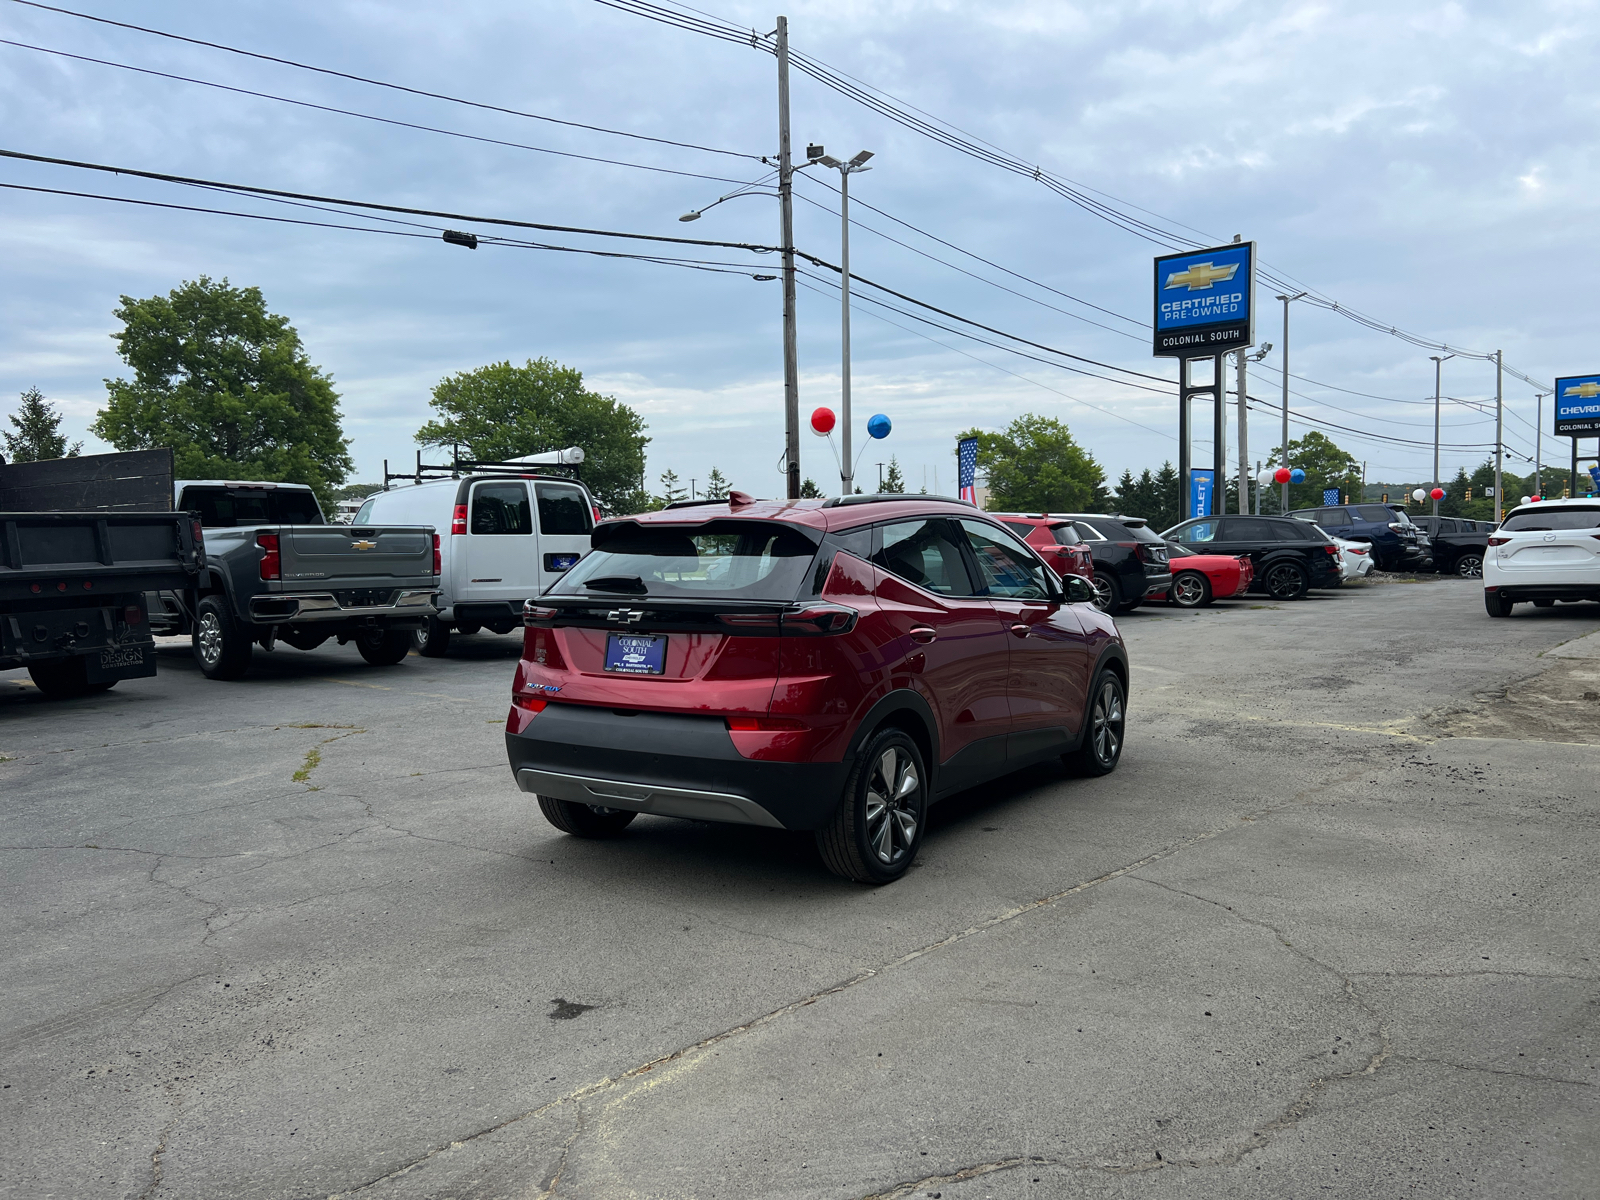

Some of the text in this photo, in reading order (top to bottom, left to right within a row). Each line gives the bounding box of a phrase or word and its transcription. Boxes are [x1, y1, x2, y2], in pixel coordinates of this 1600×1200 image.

[1161, 292, 1242, 312] CERTIFIED
[1164, 303, 1238, 321] PRE-OWNED
[1162, 330, 1240, 347] COLONIAL SOUTH
[1560, 405, 1600, 415] CHEVRO
[1559, 423, 1593, 431] COLONIAL
[619, 639, 653, 648] COLONIAL
[623, 646, 647, 654] SOUTH
[100, 648, 143, 664] DESIGN
[102, 660, 144, 669] CONSTRUCTION
